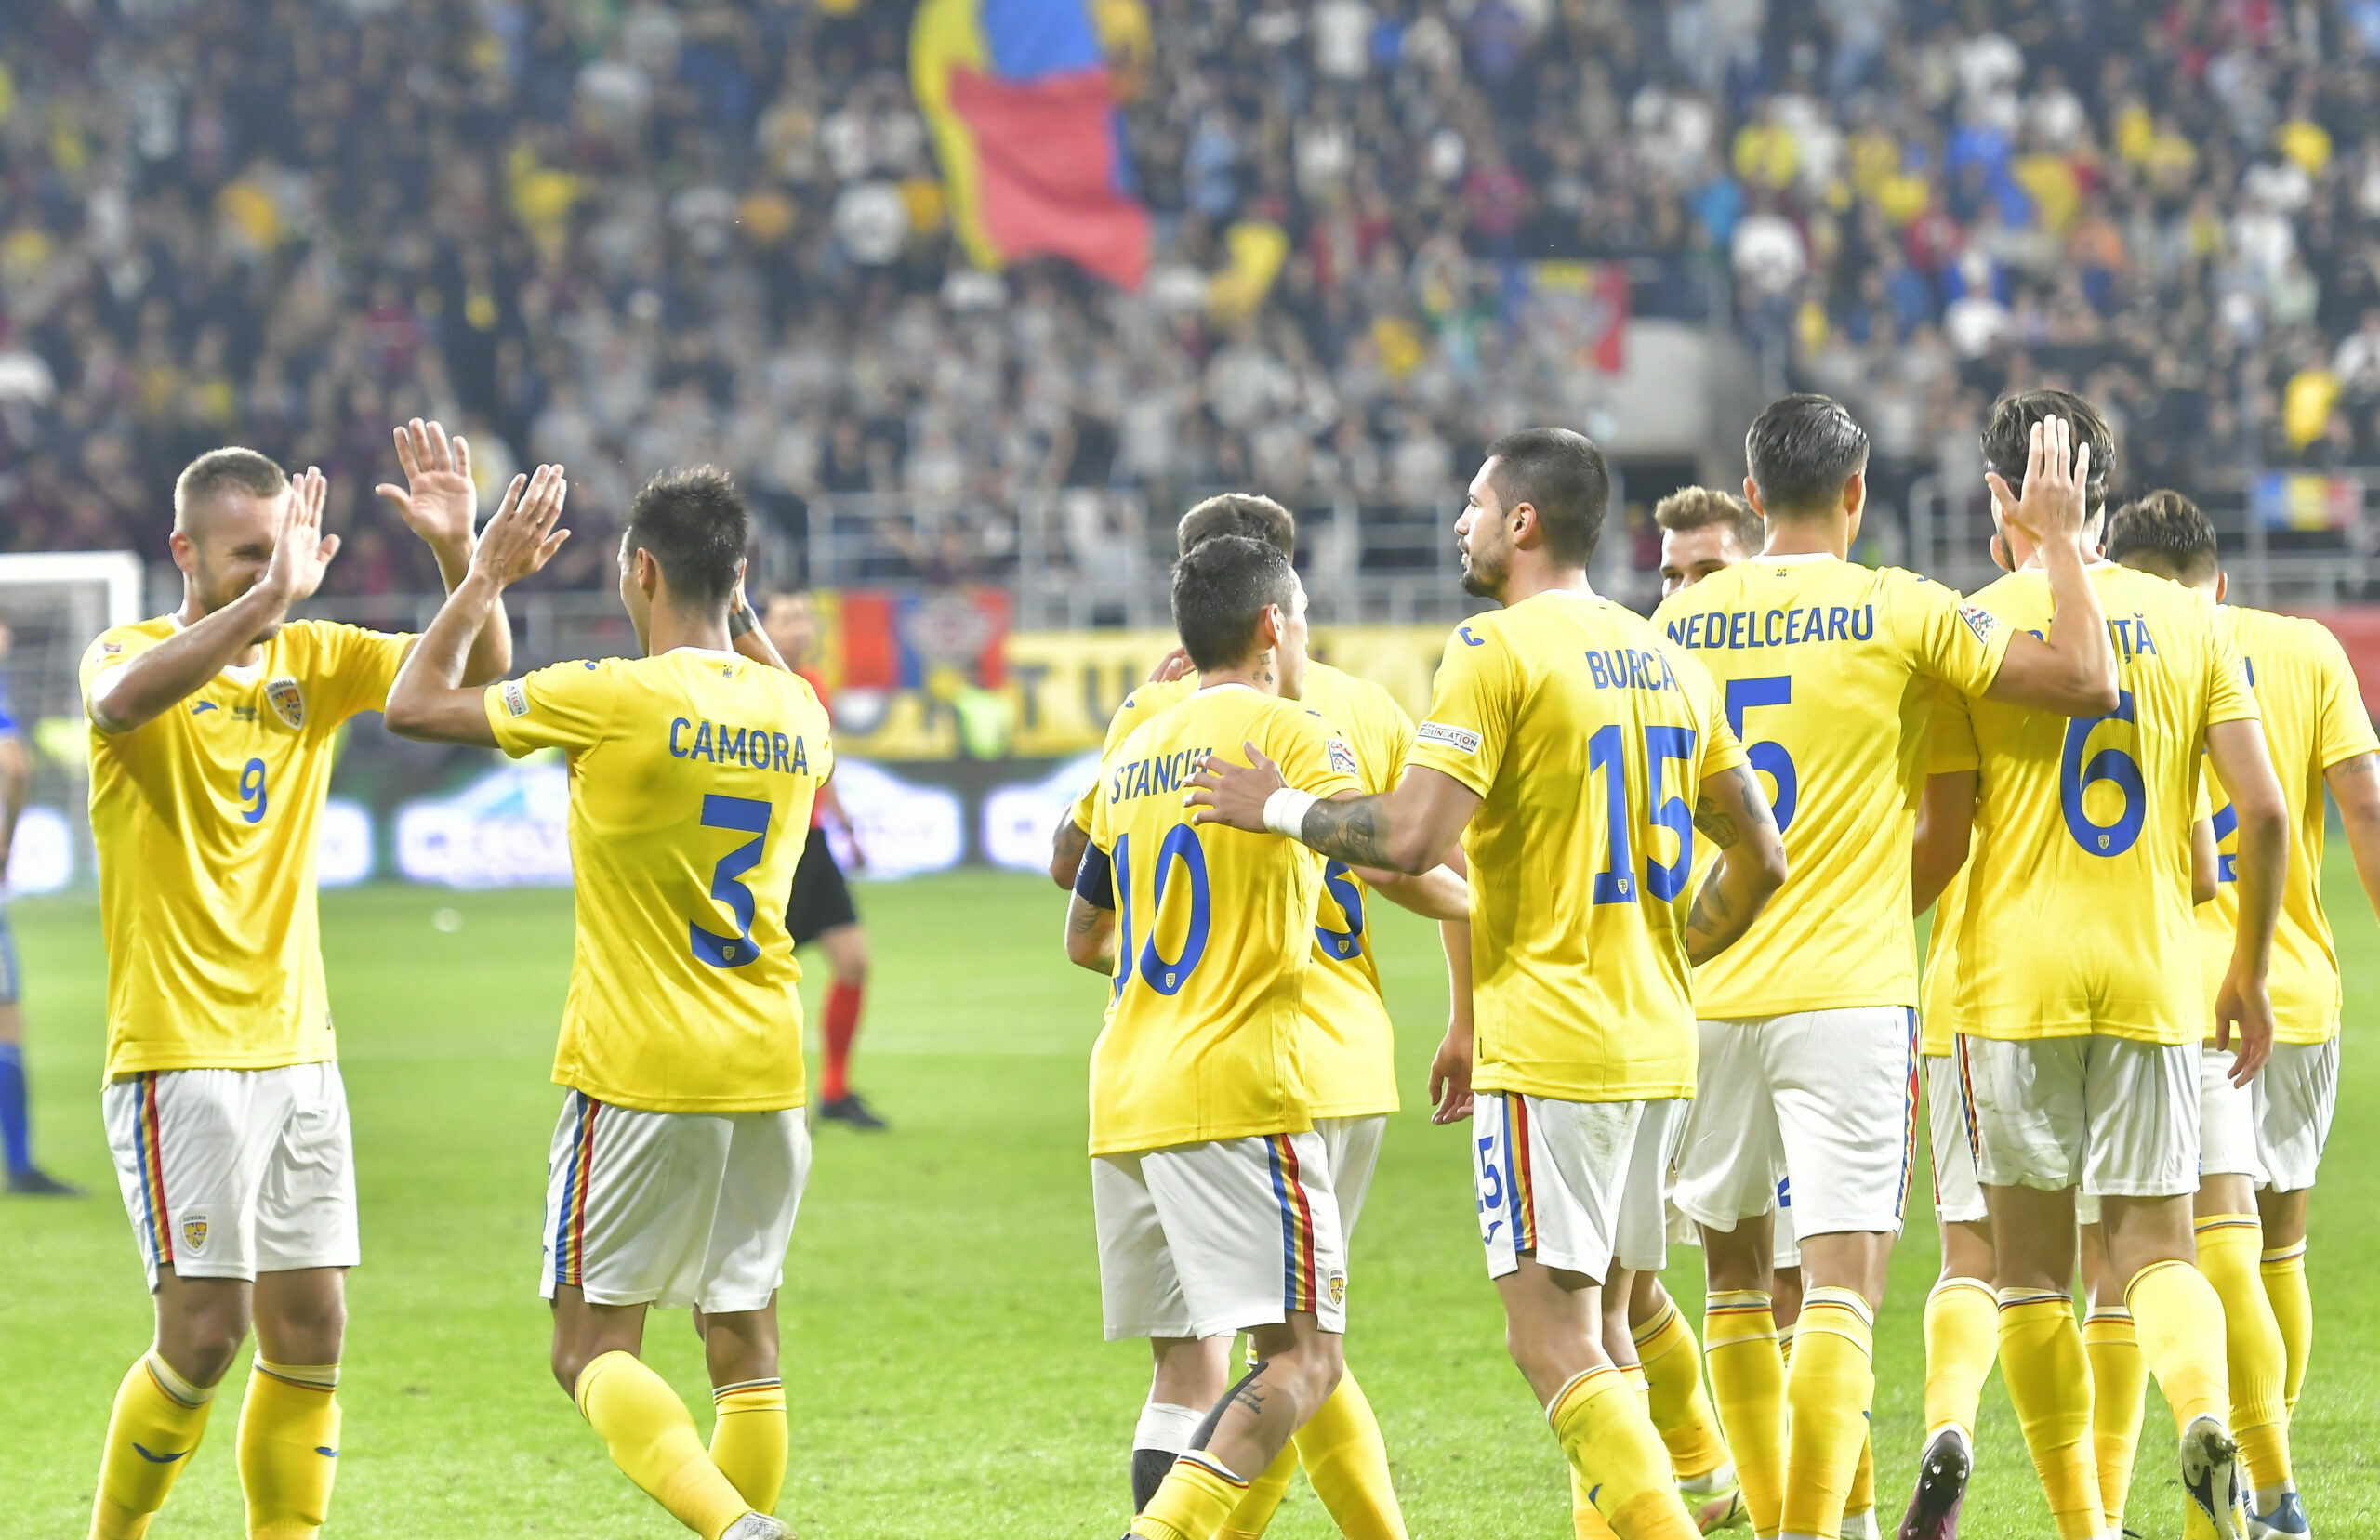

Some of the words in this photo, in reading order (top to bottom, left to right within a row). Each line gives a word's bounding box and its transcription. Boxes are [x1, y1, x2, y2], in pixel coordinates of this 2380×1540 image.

[1667, 604, 1873, 649] NEDELCEARU
[239, 757, 267, 823] 9
[669, 717, 808, 776] CAMORA
[1588, 724, 1697, 905] 15
[1726, 675, 1797, 835] 5
[2059, 689, 2146, 857] 6
[689, 794, 773, 968] 3
[1111, 823, 1211, 1007] 10
